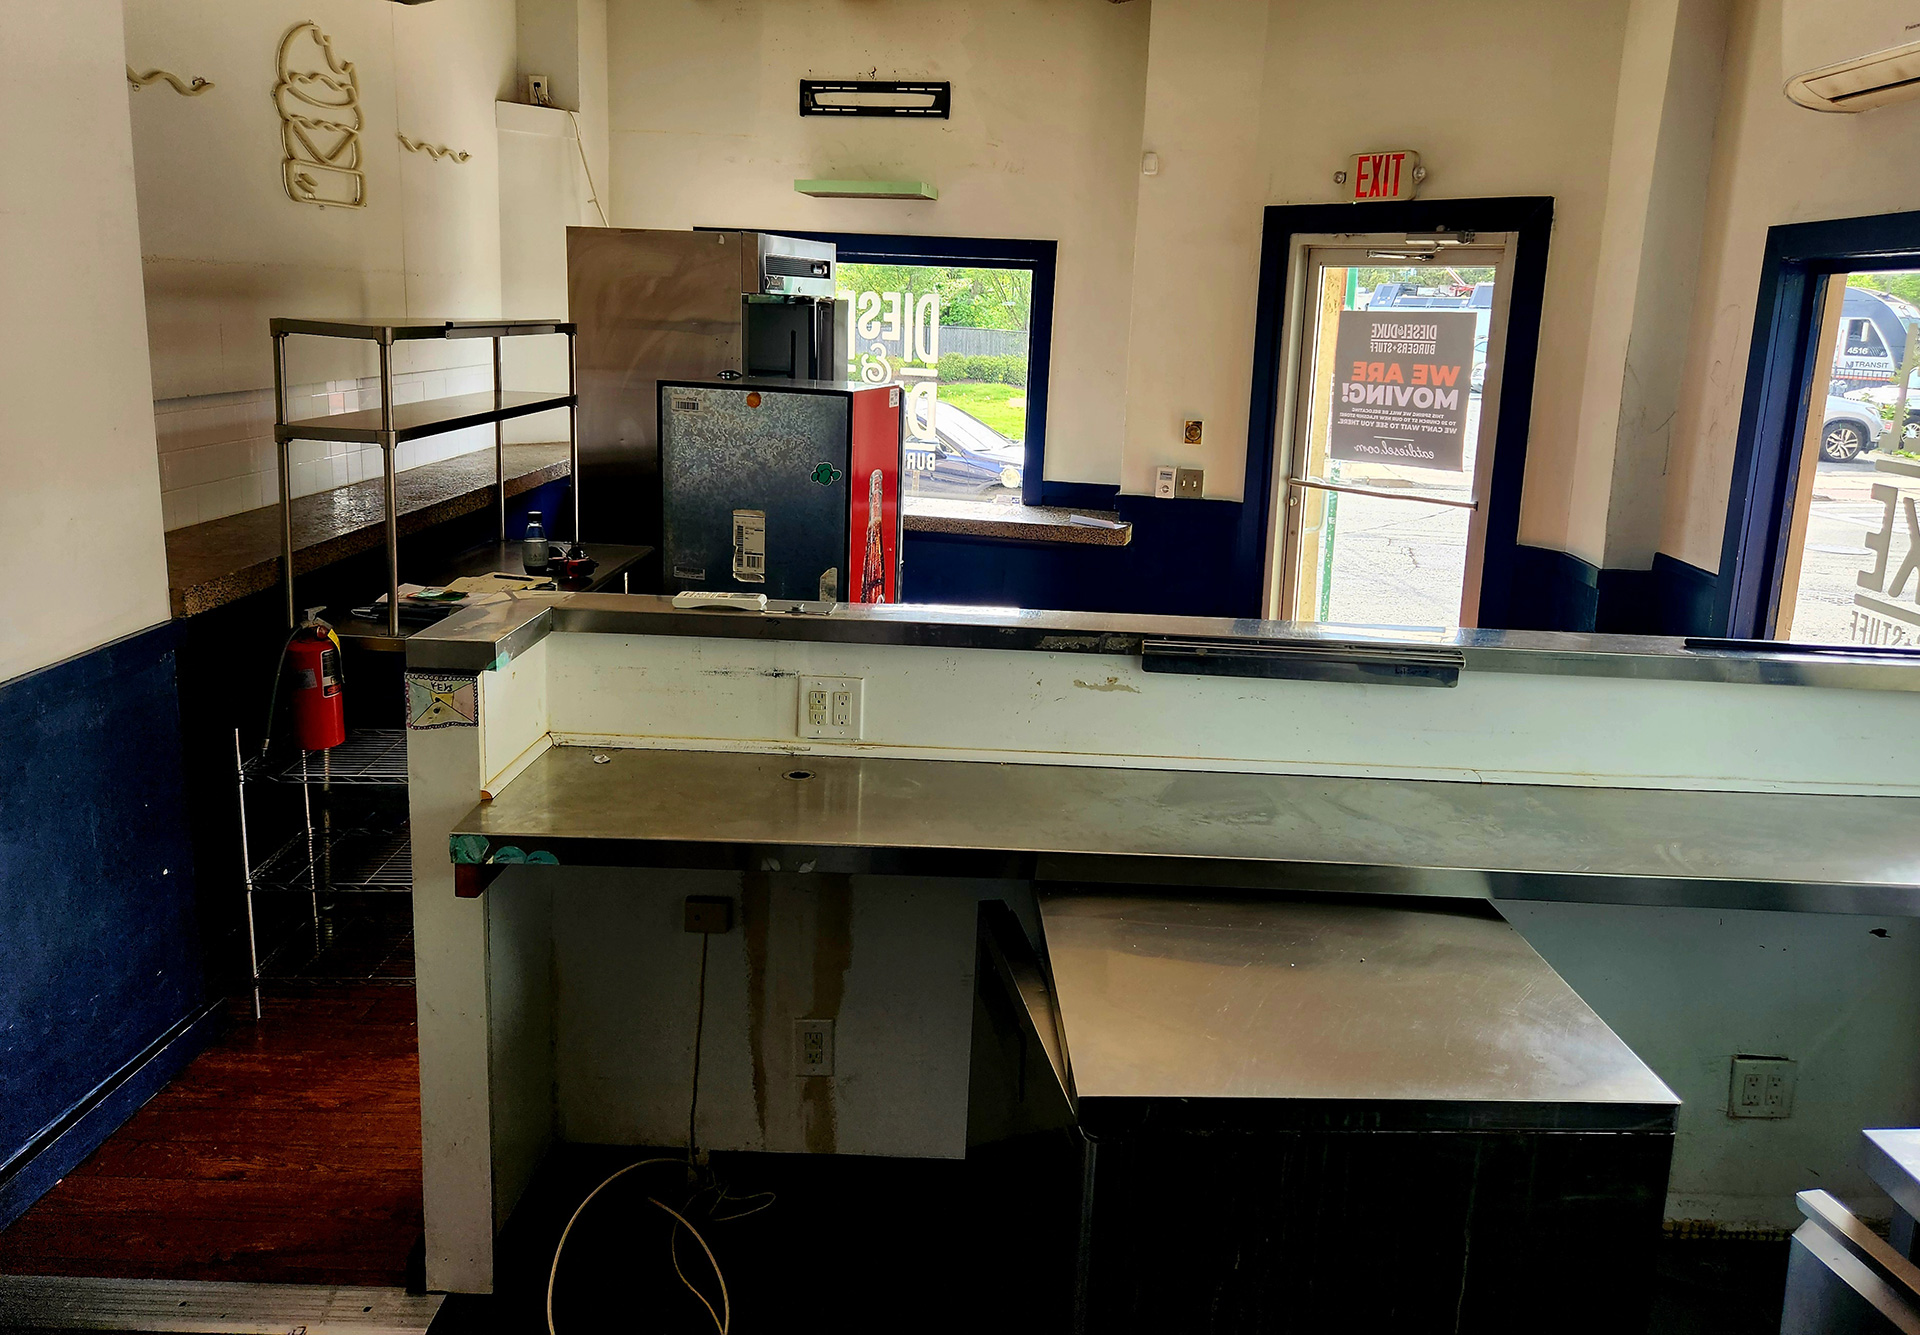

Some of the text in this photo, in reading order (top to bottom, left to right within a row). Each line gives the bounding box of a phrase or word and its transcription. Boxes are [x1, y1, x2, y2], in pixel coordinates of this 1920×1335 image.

[1355, 154, 1405, 198] EXIT
[1847, 347, 1868, 355] 4516
[1855, 361, 1889, 369] TRANSIT
